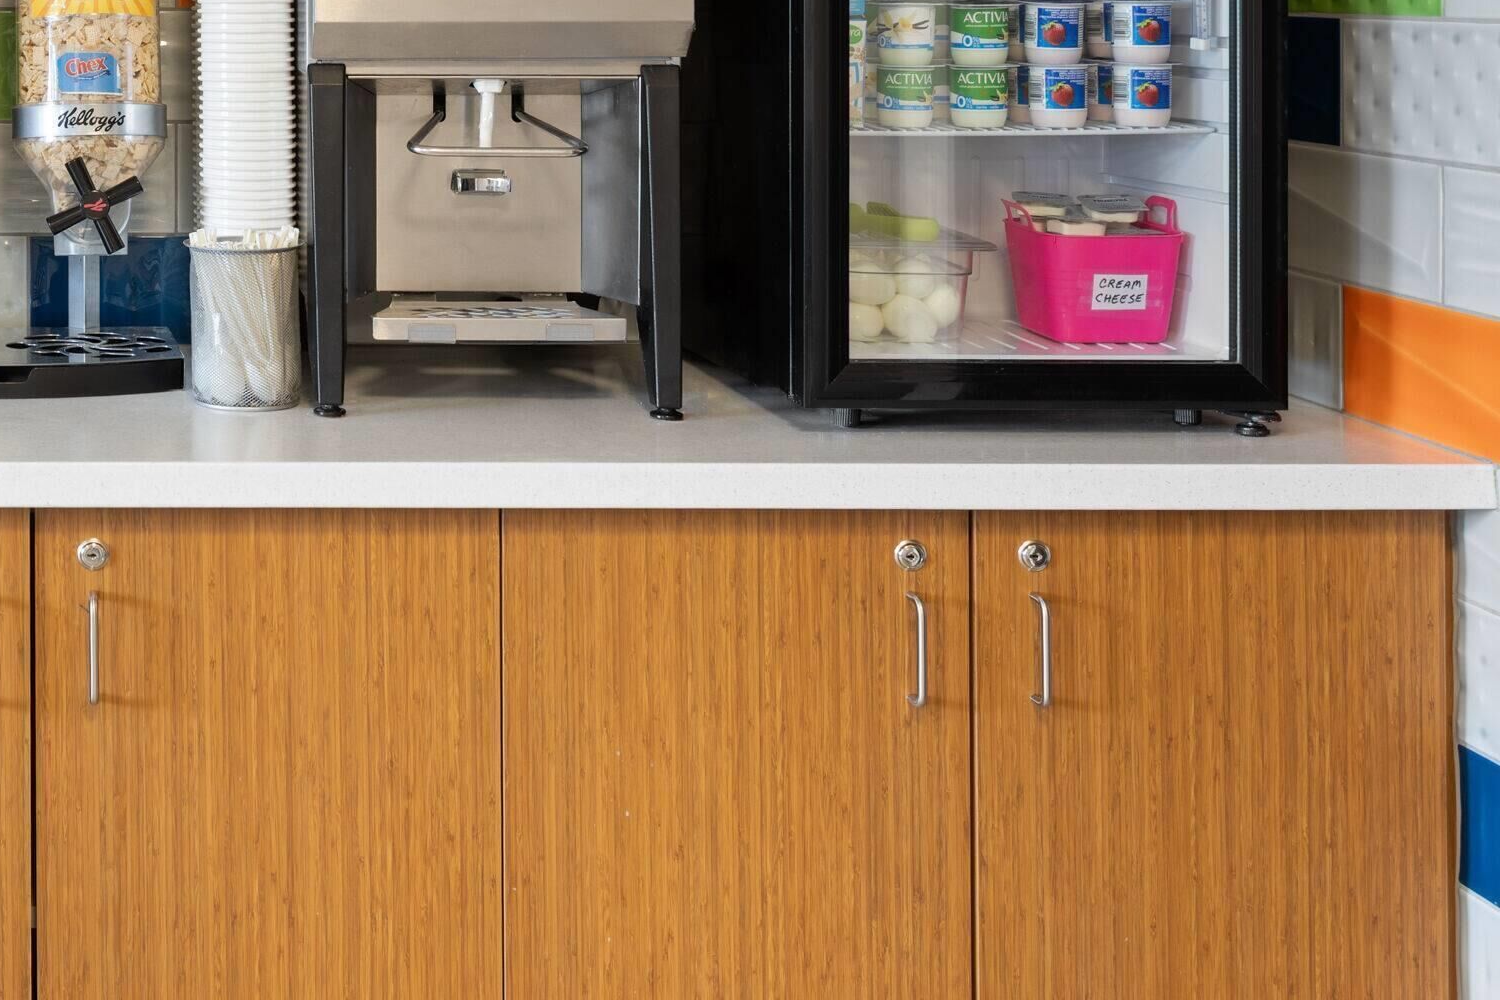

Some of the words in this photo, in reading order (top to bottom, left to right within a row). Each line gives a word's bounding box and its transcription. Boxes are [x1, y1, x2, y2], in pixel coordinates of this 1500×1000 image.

[65, 56, 108, 77] Chex
[885, 73, 933, 85] ACTIVIA
[957, 72, 1006, 85] ACTIVIA
[57, 106, 126, 132] Kellogg's
[1098, 278, 1142, 290] CREAM
[1095, 293, 1145, 304] CHEESE
